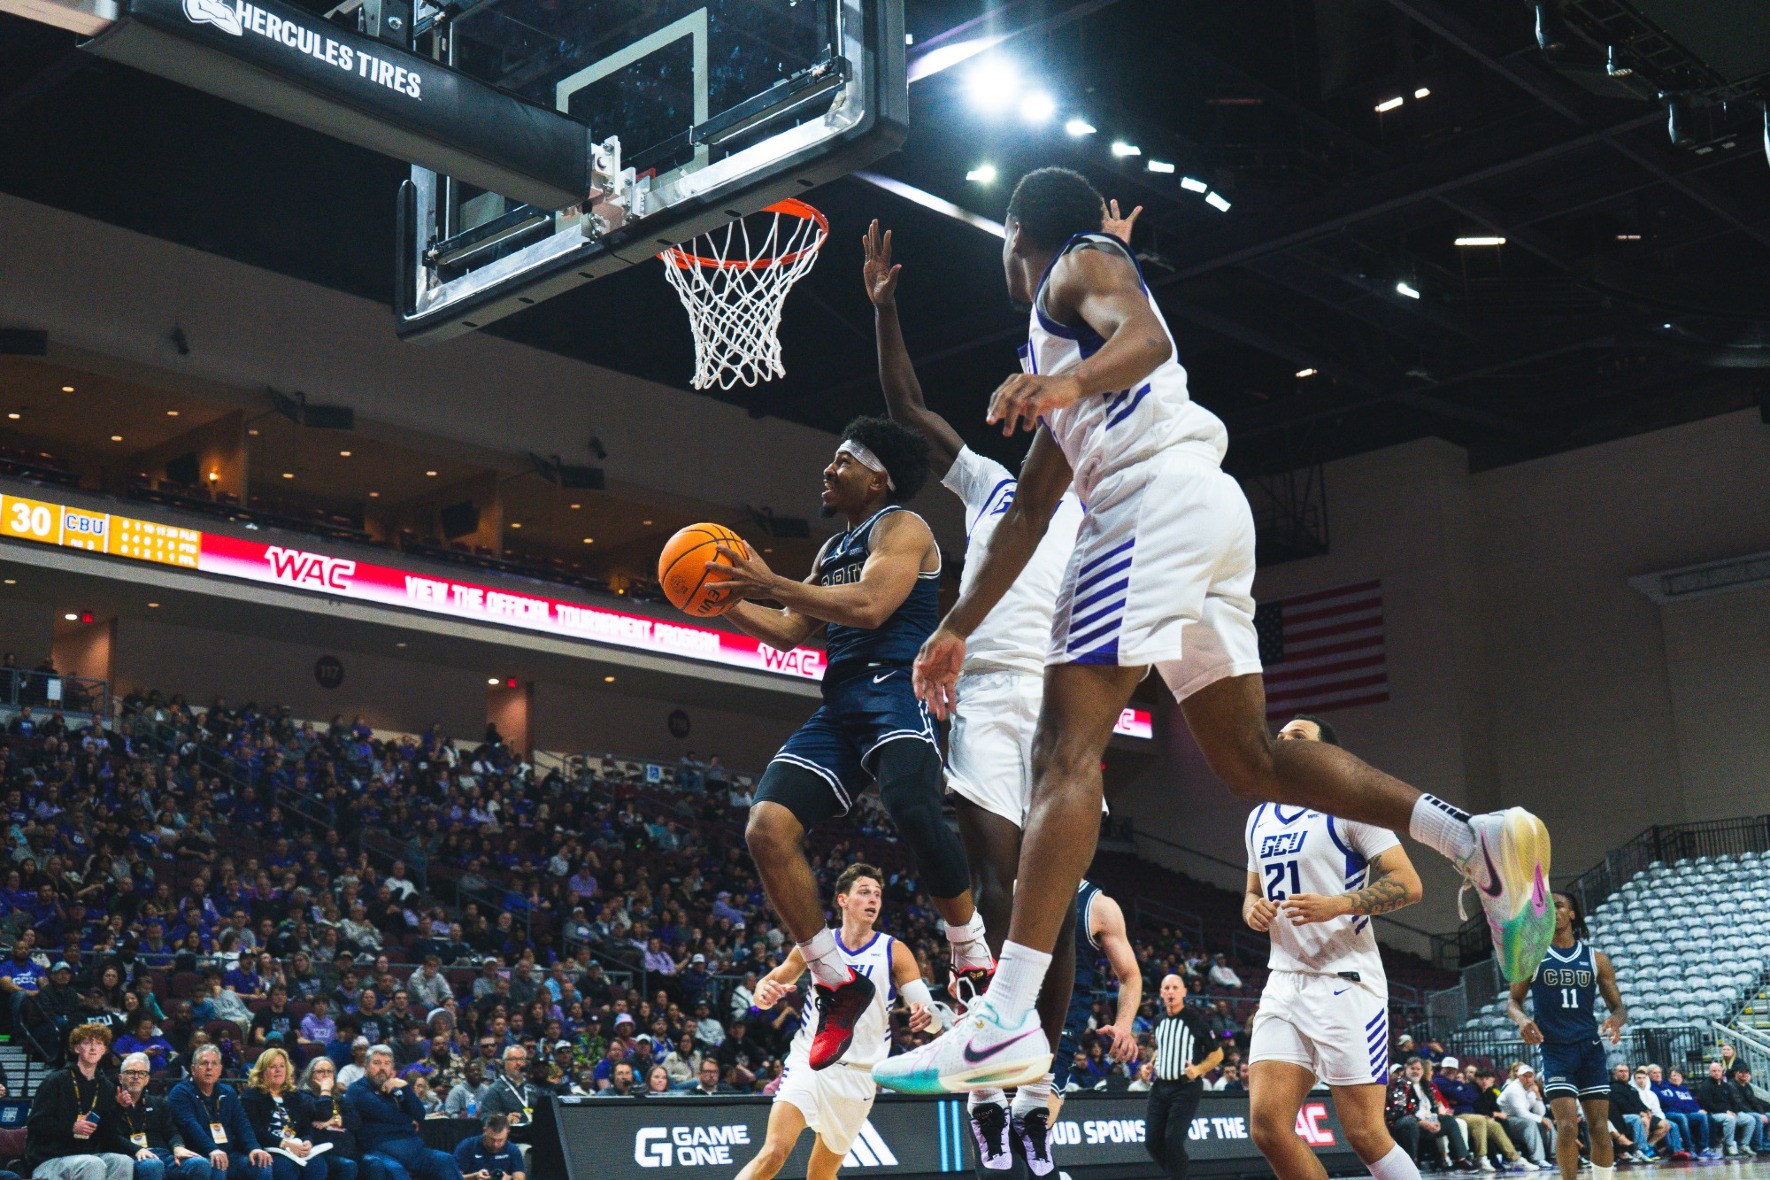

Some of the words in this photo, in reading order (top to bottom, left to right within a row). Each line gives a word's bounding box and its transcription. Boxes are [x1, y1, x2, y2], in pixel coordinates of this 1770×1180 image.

[235, 0, 354, 71] HERCULES
[356, 51, 422, 99] TIRES
[11, 502, 51, 537] 30
[66, 514, 105, 535] CBU
[265, 546, 356, 591] WAC
[405, 576, 448, 604] VIEW
[452, 585, 483, 611] THE
[486, 592, 550, 622] OFFICIAL
[556, 604, 652, 641] TOURNAMENT
[654, 623, 720, 652] PROGRAM
[757, 643, 819, 676] WAC
[1260, 831, 1308, 859] GCU
[1265, 860, 1301, 902] 21
[1544, 968, 1592, 987] CBU
[1560, 988, 1579, 1009] 11
[672, 1125, 751, 1146] GAME
[1188, 1117, 1210, 1141] OF
[1211, 1116, 1248, 1140] THE
[677, 1146, 733, 1166] ONE
